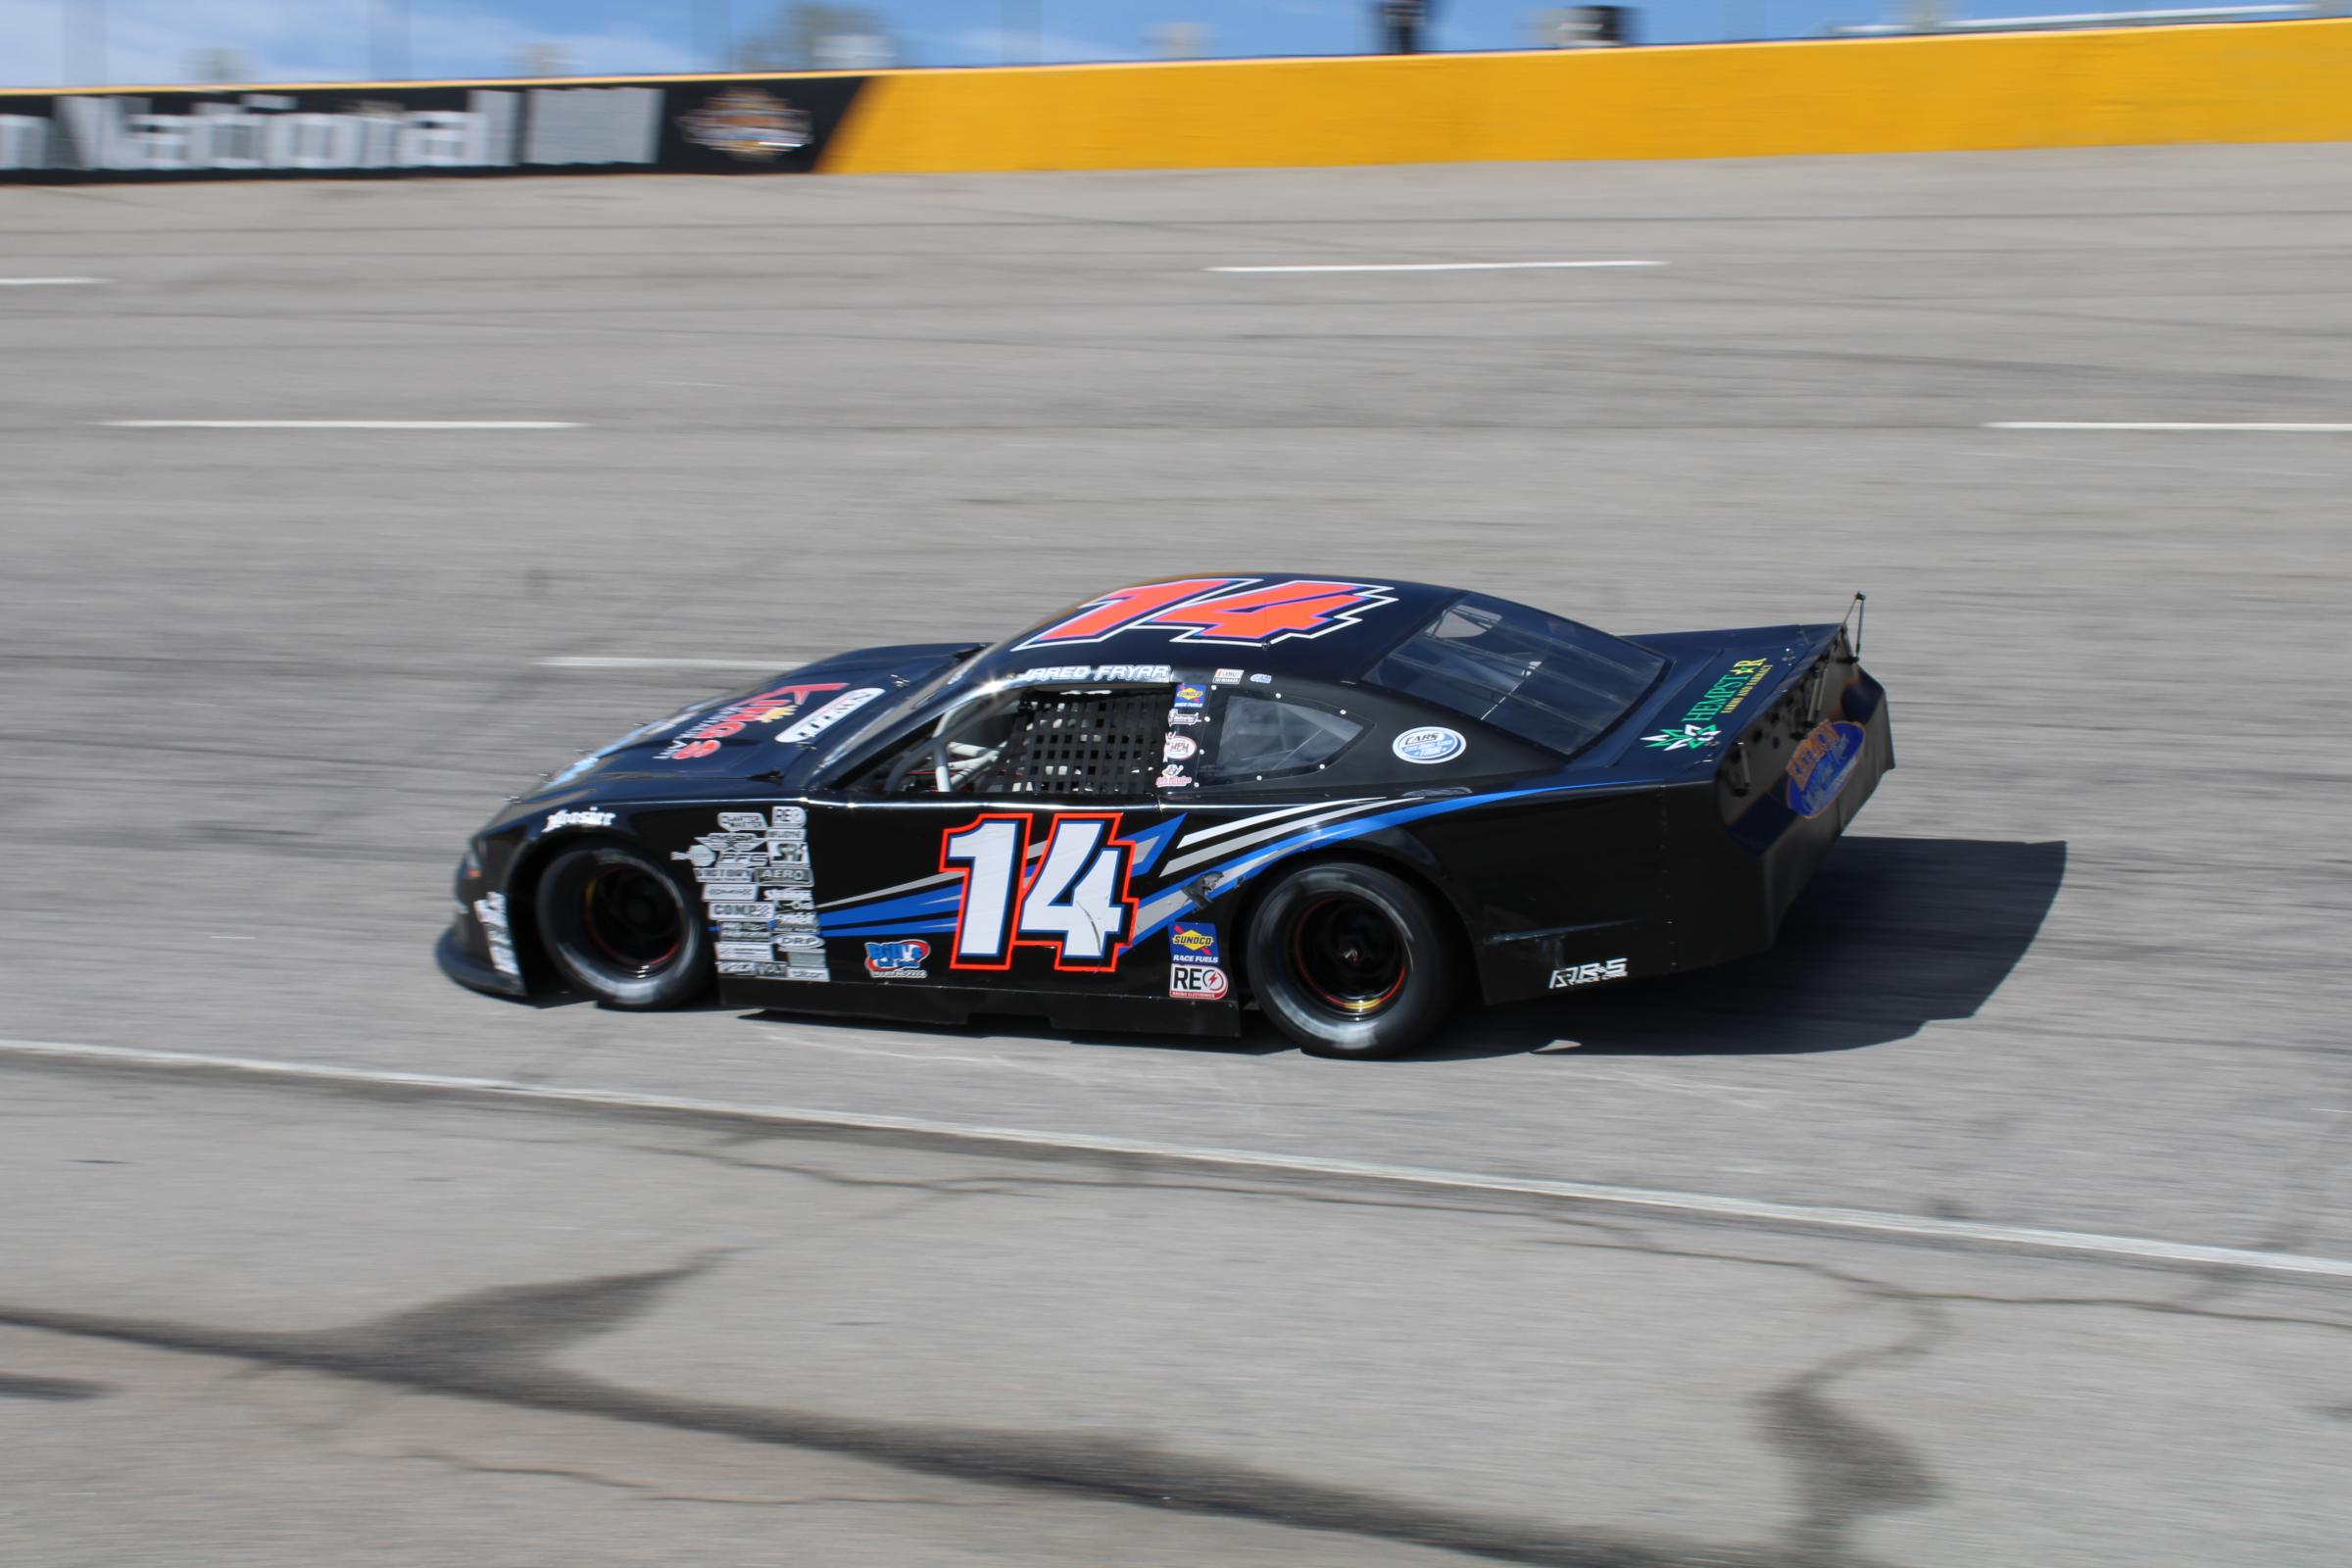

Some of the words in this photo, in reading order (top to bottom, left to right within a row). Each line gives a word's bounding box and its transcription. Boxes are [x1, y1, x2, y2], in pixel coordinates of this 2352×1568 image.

[1011, 578, 1398, 652] 14
[1019, 665, 1091, 682] JARED
[1094, 664, 1171, 682] FRYAR
[760, 868, 805, 880] AERO
[939, 812, 1140, 973] 14
[1174, 935, 1212, 946] SUNOCO
